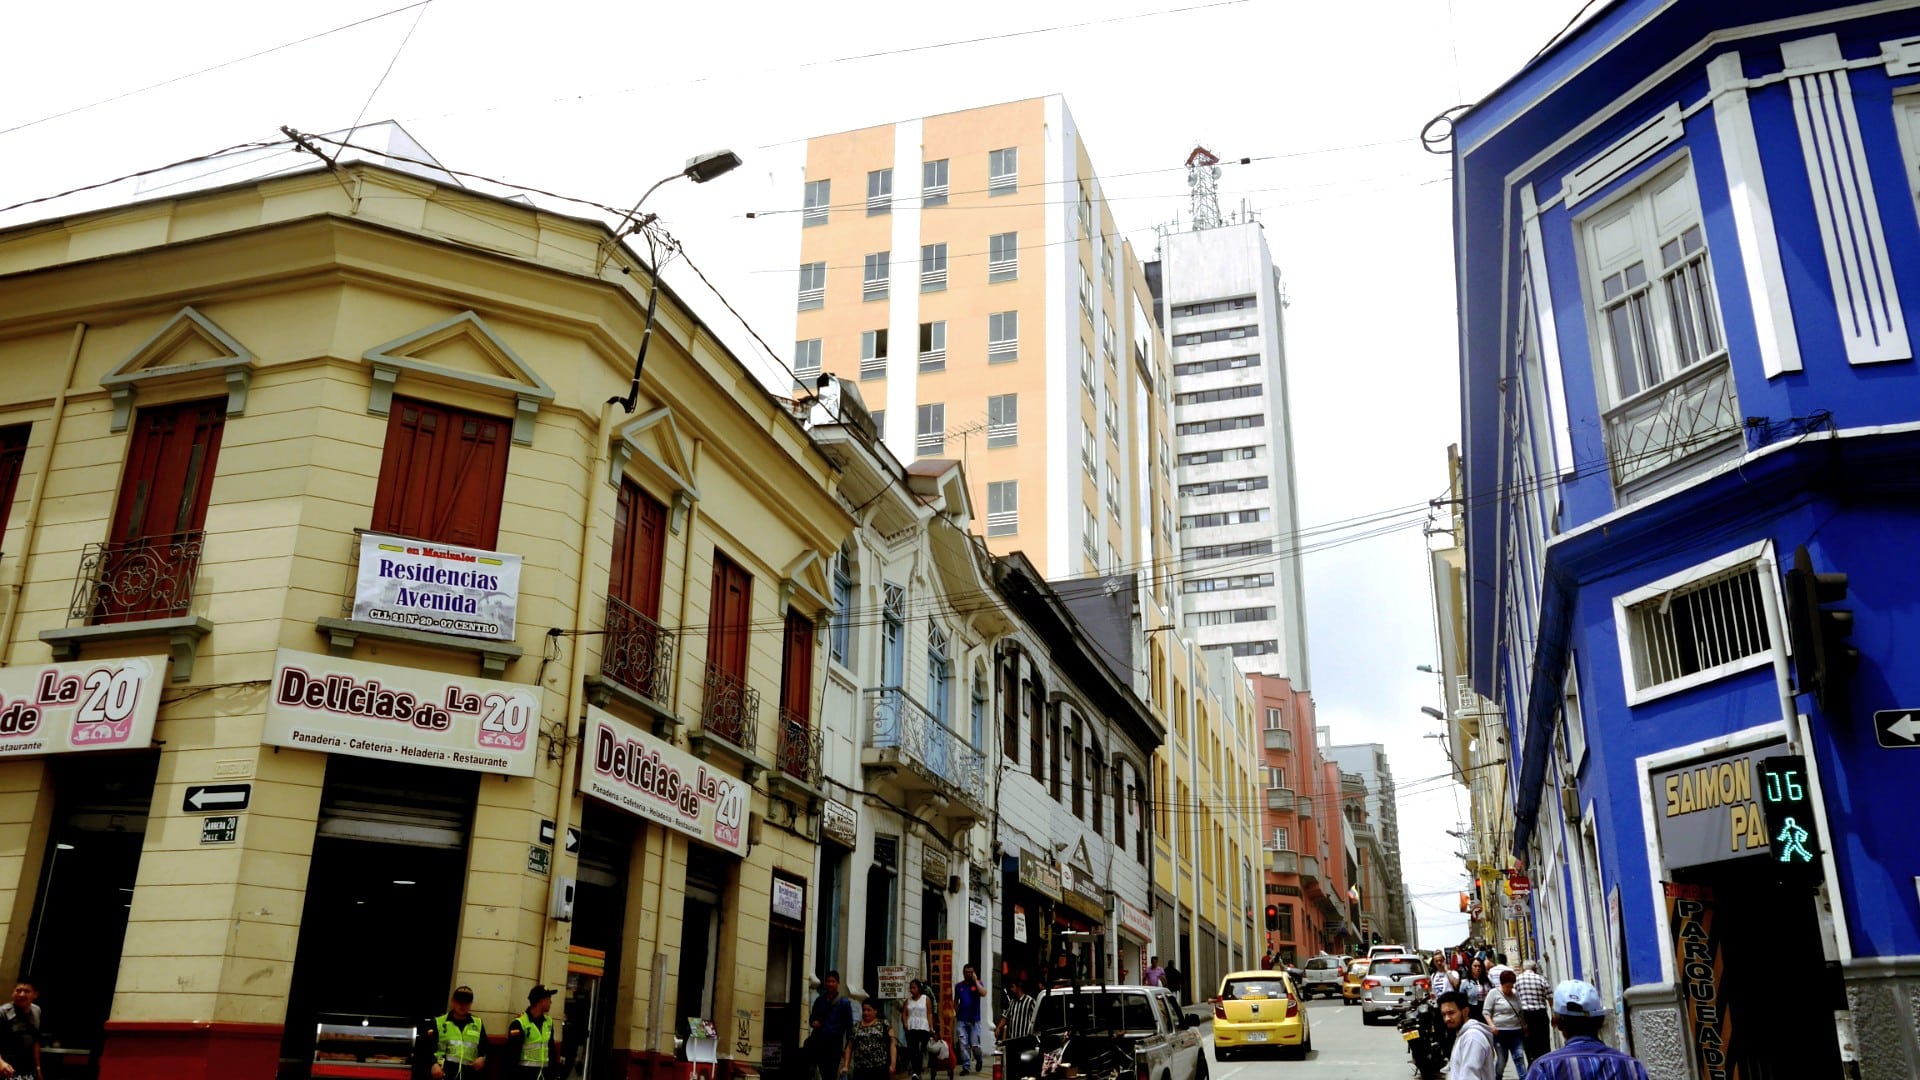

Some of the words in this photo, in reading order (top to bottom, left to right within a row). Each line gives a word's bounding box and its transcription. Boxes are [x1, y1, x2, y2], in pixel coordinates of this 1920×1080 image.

[406, 546, 419, 556] en
[379, 558, 498, 591] Residencias
[396, 587, 477, 614] Avenida
[369, 609, 390, 621] CLL
[391, 612, 404, 623] 21
[420, 616, 433, 627] 20
[440, 619, 453, 629] 07
[455, 620, 498, 634] CENTRO
[0, 704, 38, 733] de
[40, 674, 79, 702] La
[77, 668, 140, 723] 20
[280, 668, 414, 721] Delicias
[414, 704, 449, 730] de
[447, 687, 480, 713] La
[481, 695, 529, 735] 20
[452, 752, 508, 768] Restaurante
[597, 727, 680, 804] Delicias
[680, 787, 699, 818] de
[699, 768, 717, 801] La
[716, 779, 744, 830] 20
[1665, 757, 1752, 818] SAIMON
[1765, 771, 1804, 802] 06
[1730, 801, 1769, 853] PA
